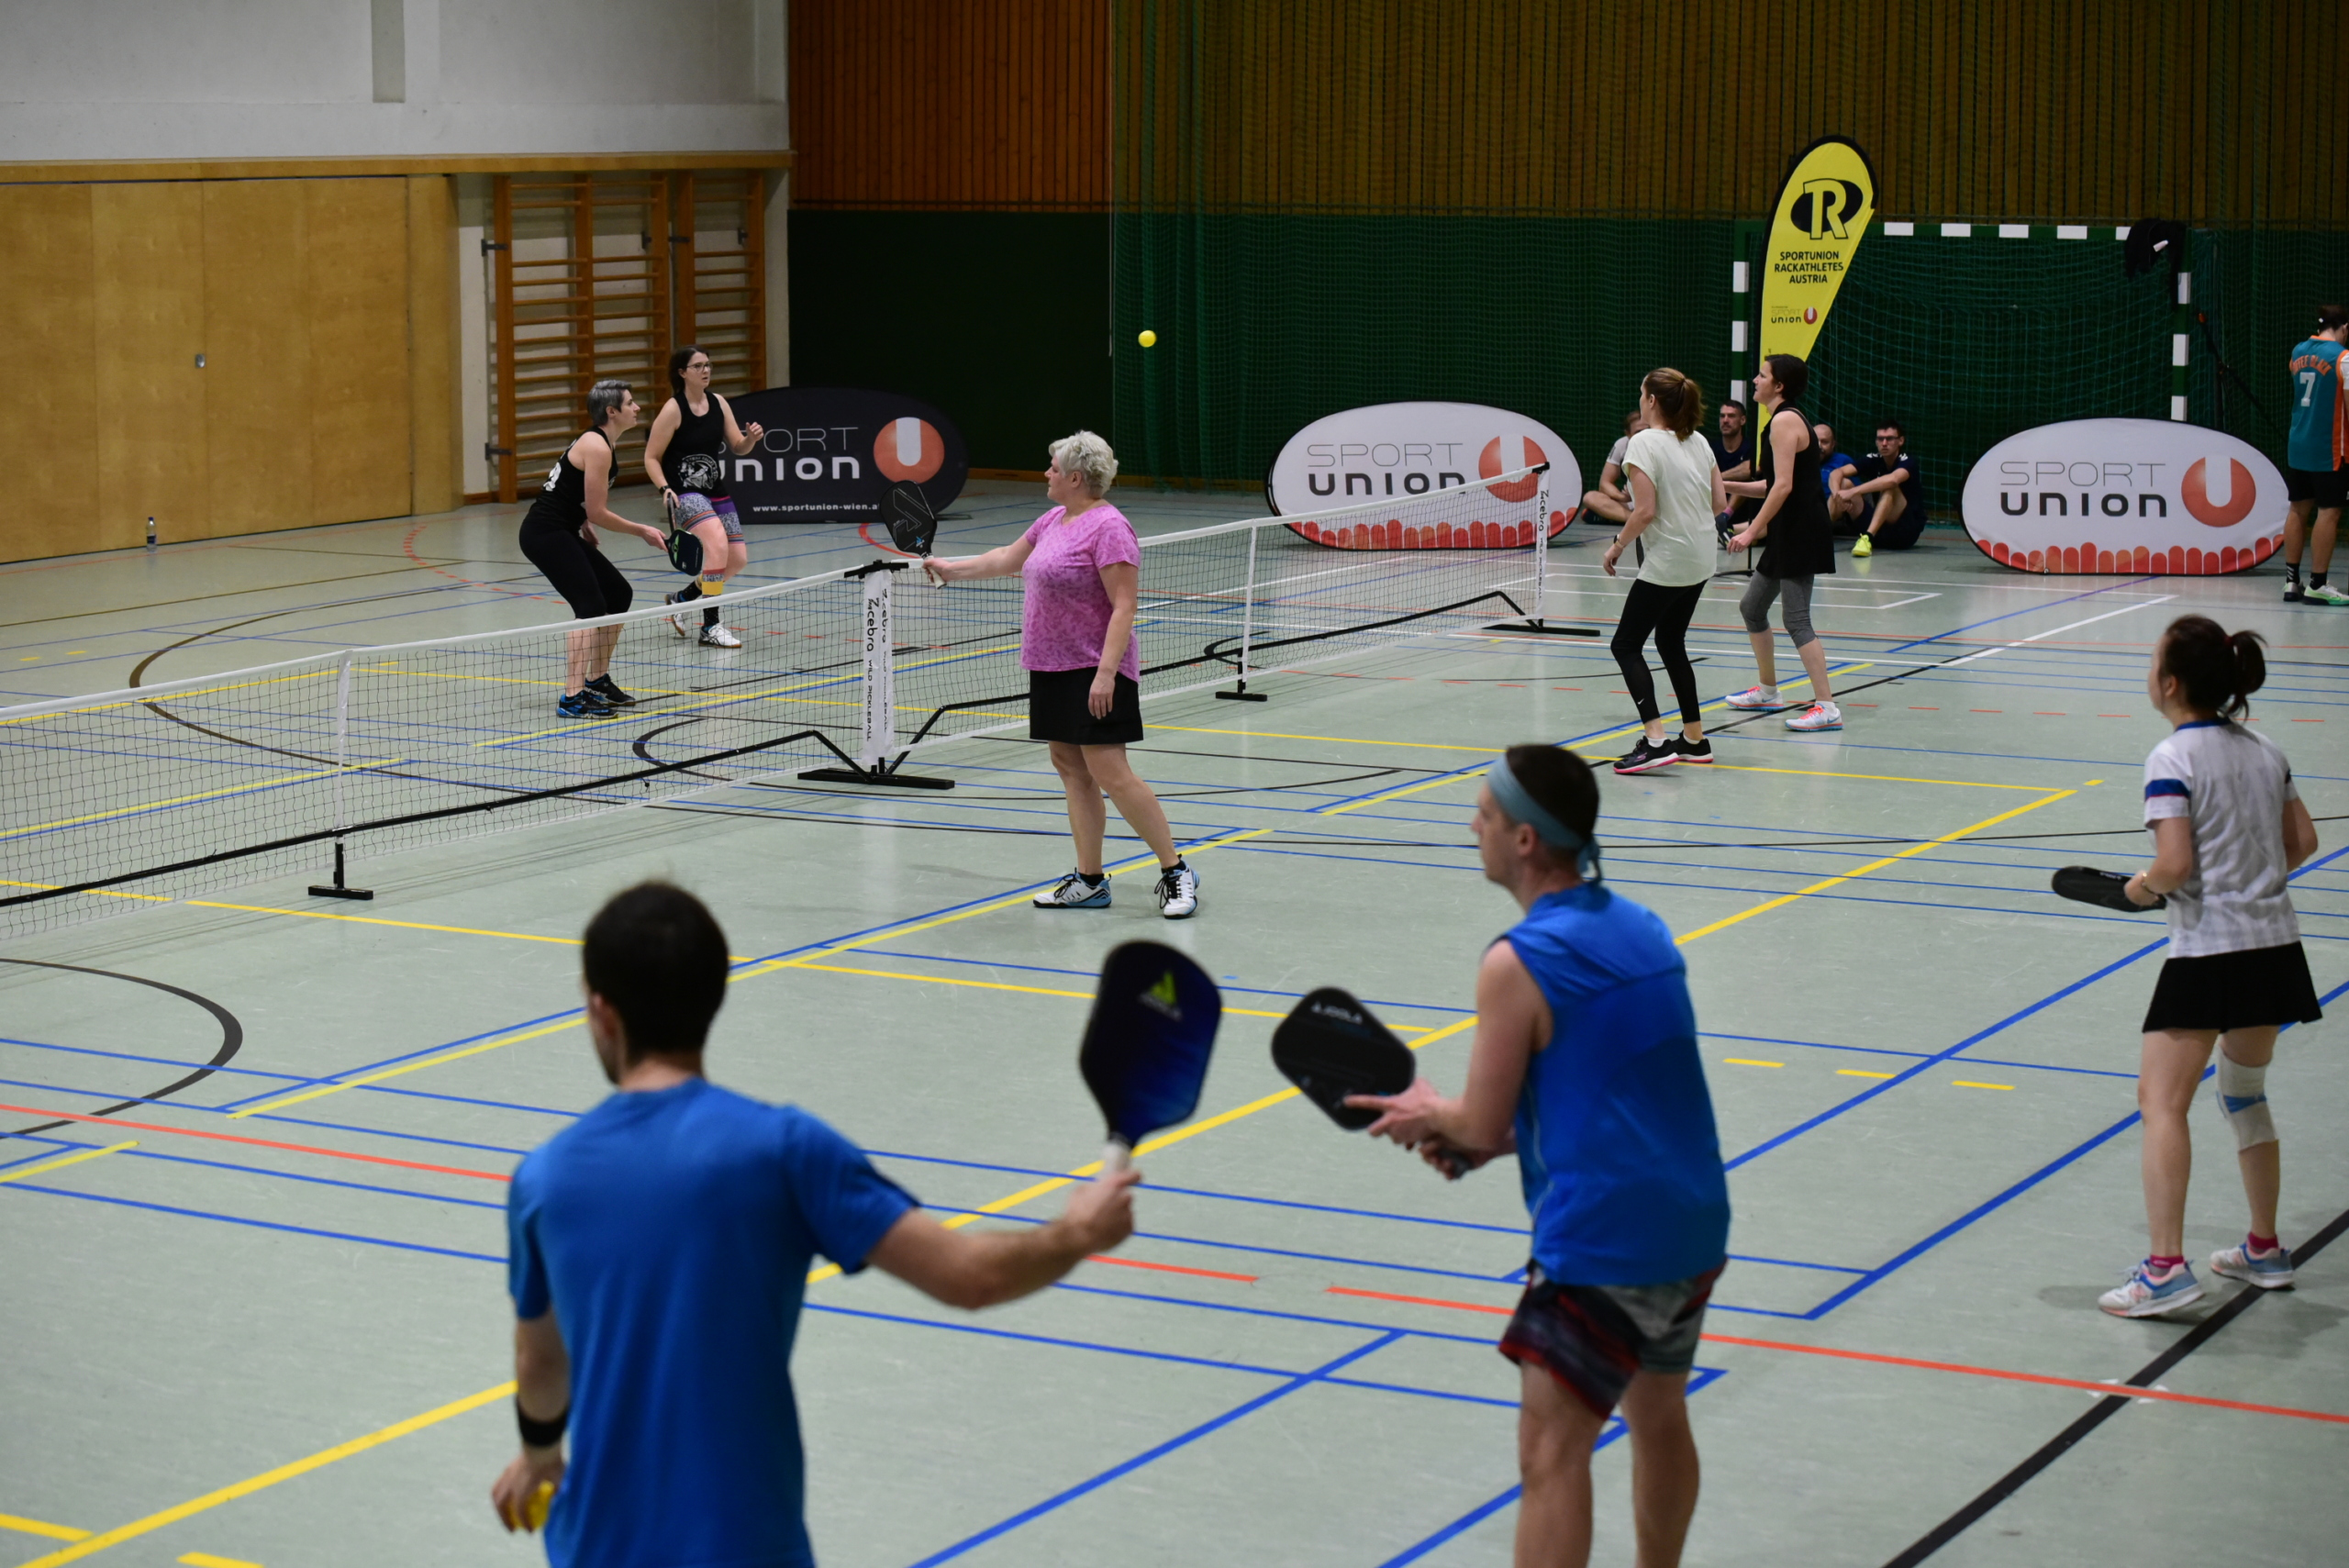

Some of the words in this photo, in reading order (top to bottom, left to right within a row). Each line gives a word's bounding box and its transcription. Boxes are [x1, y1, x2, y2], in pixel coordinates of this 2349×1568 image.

[1803, 178, 1848, 239] R
[1775, 262, 1844, 272] RACKATHLETES
[1780, 250, 1839, 261] SPORTUNION
[1789, 274, 1828, 284] AUSTRIA
[2299, 372, 2316, 407] 7
[718, 427, 858, 455] ORT
[1308, 443, 1464, 467] SPORT
[2000, 462, 2165, 487] SPORT
